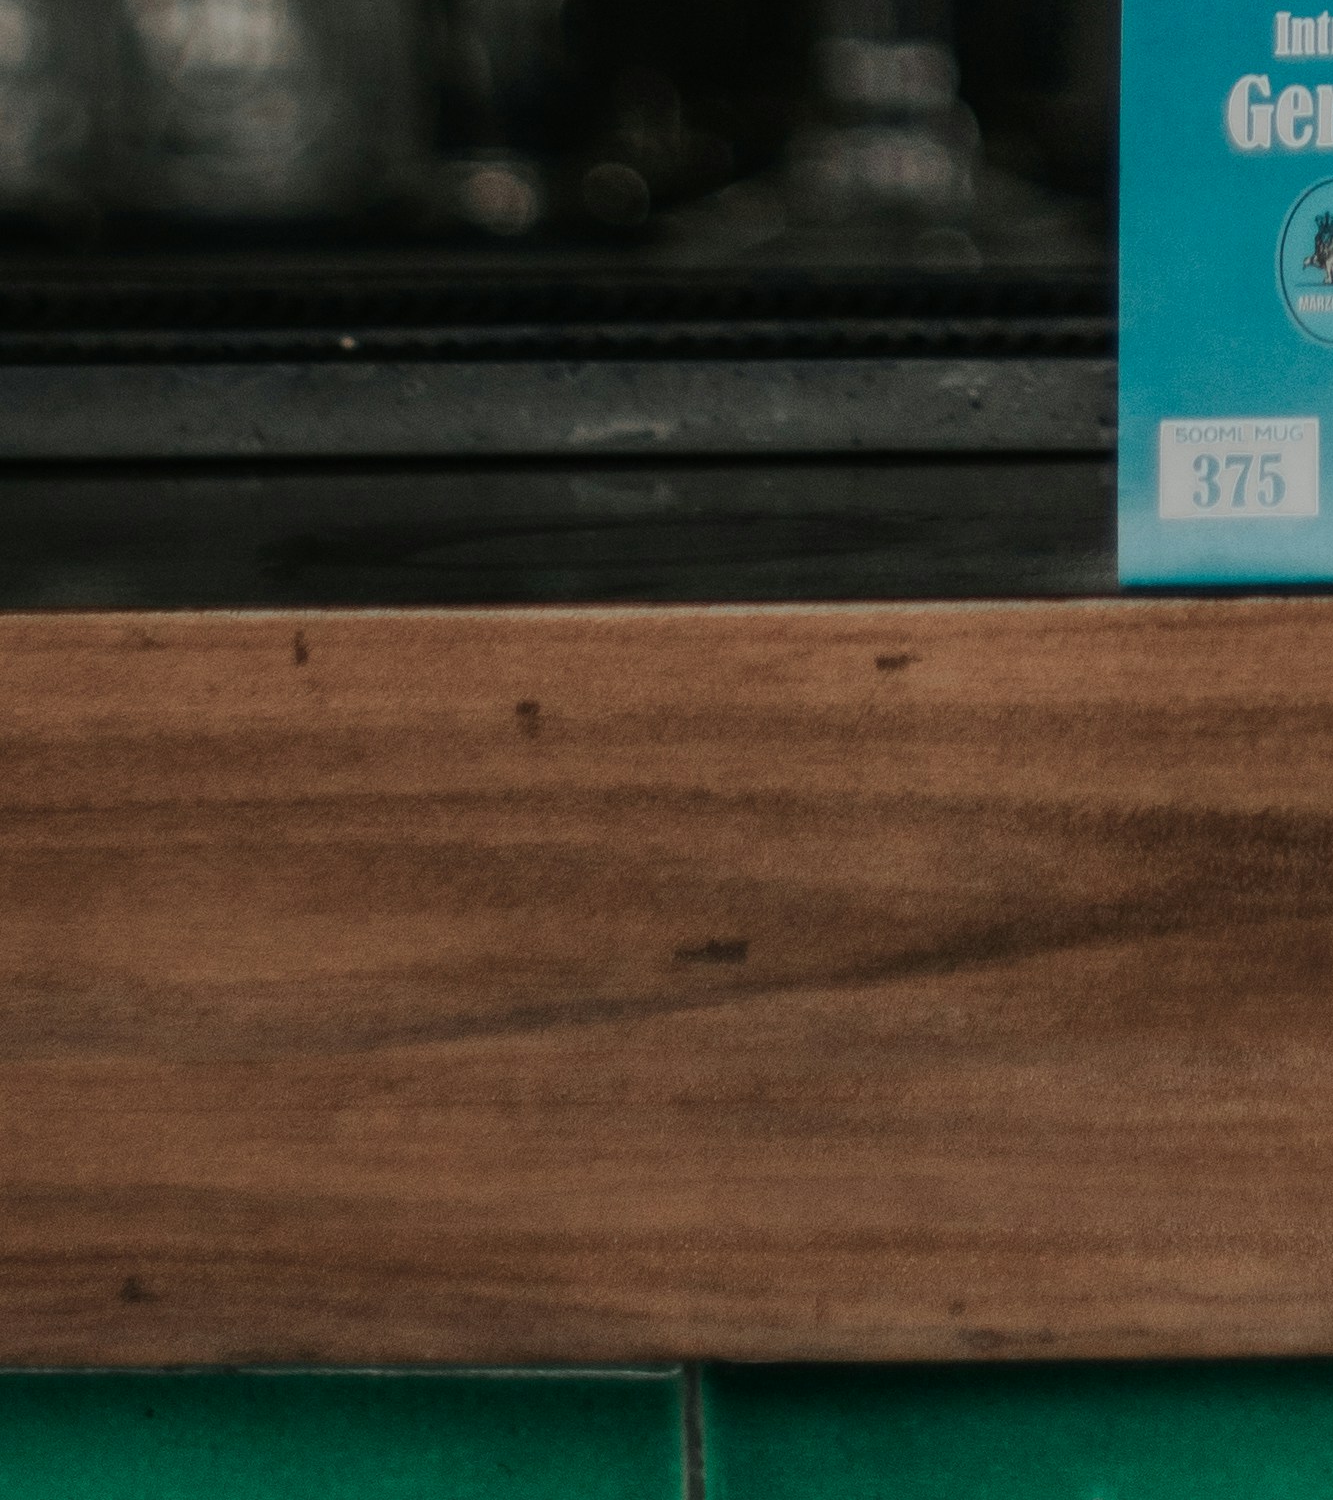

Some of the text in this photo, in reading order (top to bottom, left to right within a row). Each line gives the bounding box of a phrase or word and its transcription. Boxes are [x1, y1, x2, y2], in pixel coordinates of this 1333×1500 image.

[1175, 424, 1304, 443] 500ML MUG
[1192, 452, 1286, 509] 375
